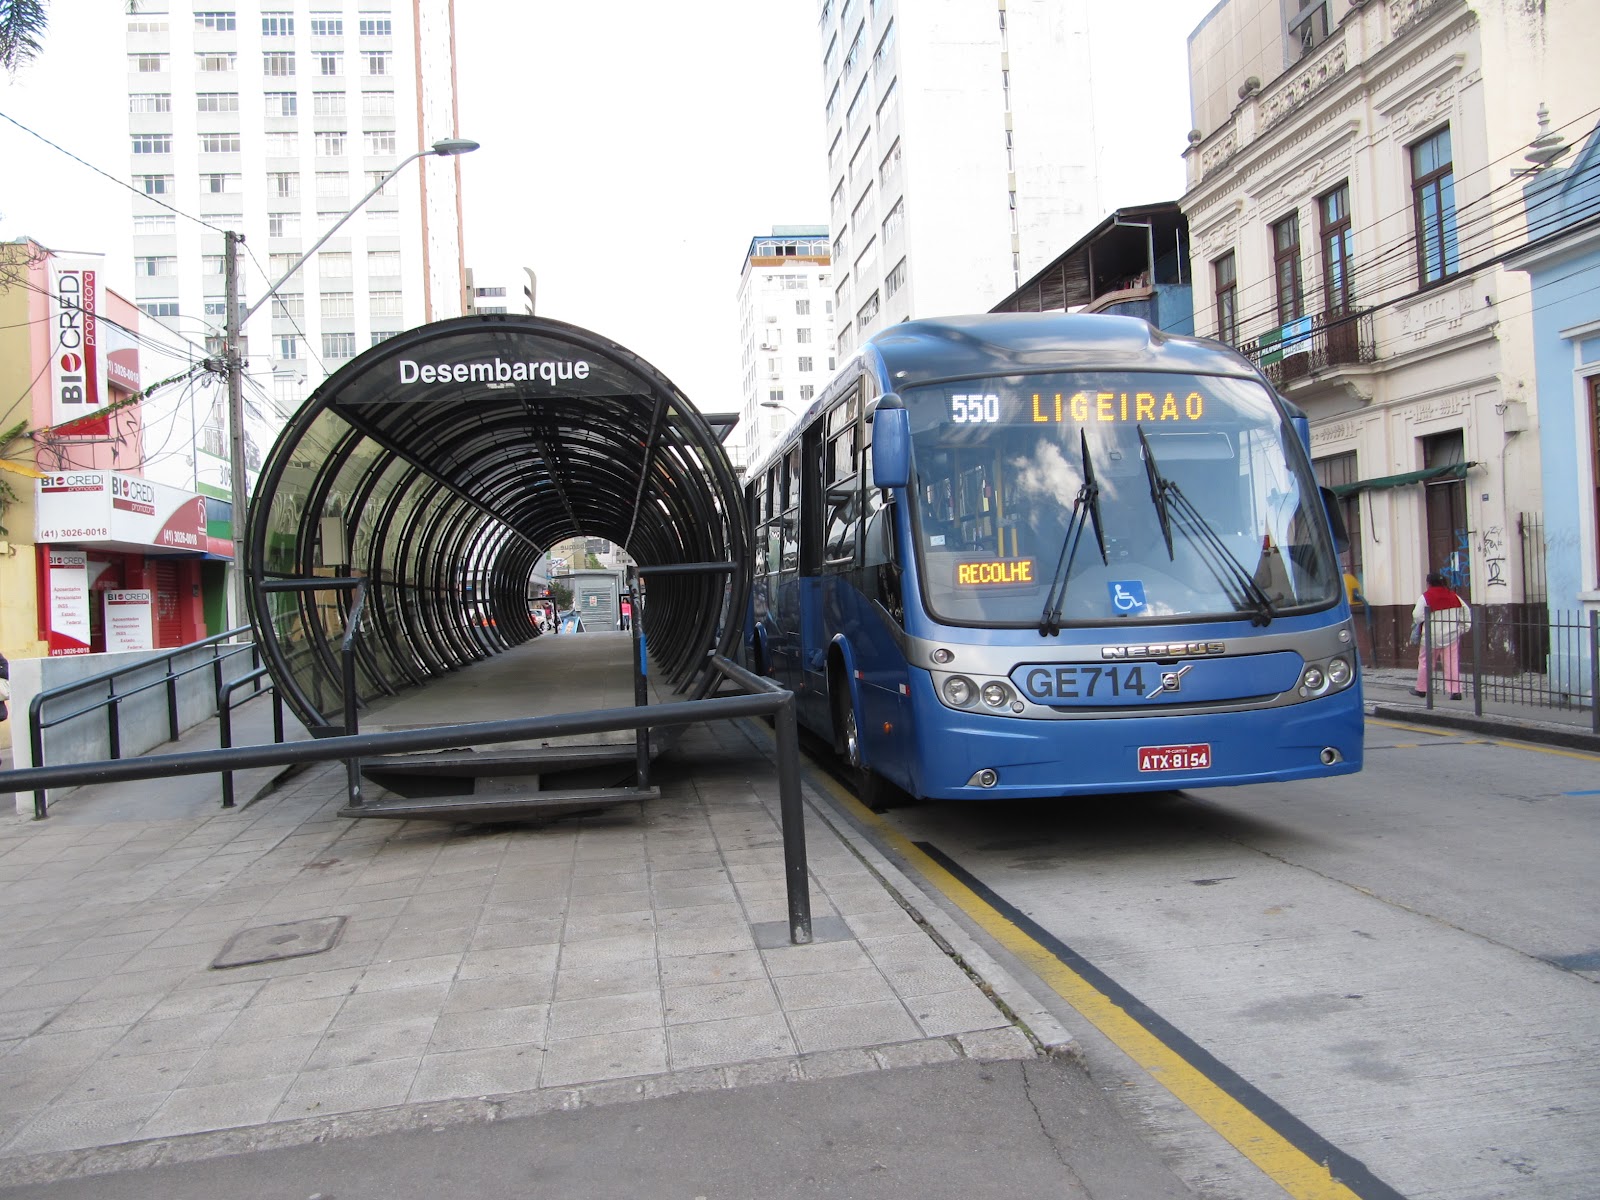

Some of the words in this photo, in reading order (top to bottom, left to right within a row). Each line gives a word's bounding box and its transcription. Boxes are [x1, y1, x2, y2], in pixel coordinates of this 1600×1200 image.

[84, 272, 96, 346] promotora
[399, 358, 590, 386] Desembarque
[952, 394, 1000, 423] 550
[1032, 392, 1203, 422] LIGEIRAO
[41, 530, 58, 539] (41)
[61, 528, 107, 537] 3026-0018
[958, 561, 1032, 584] RECOLHE
[1101, 642, 1225, 659] NEOBUS
[1026, 667, 1146, 697] GE714
